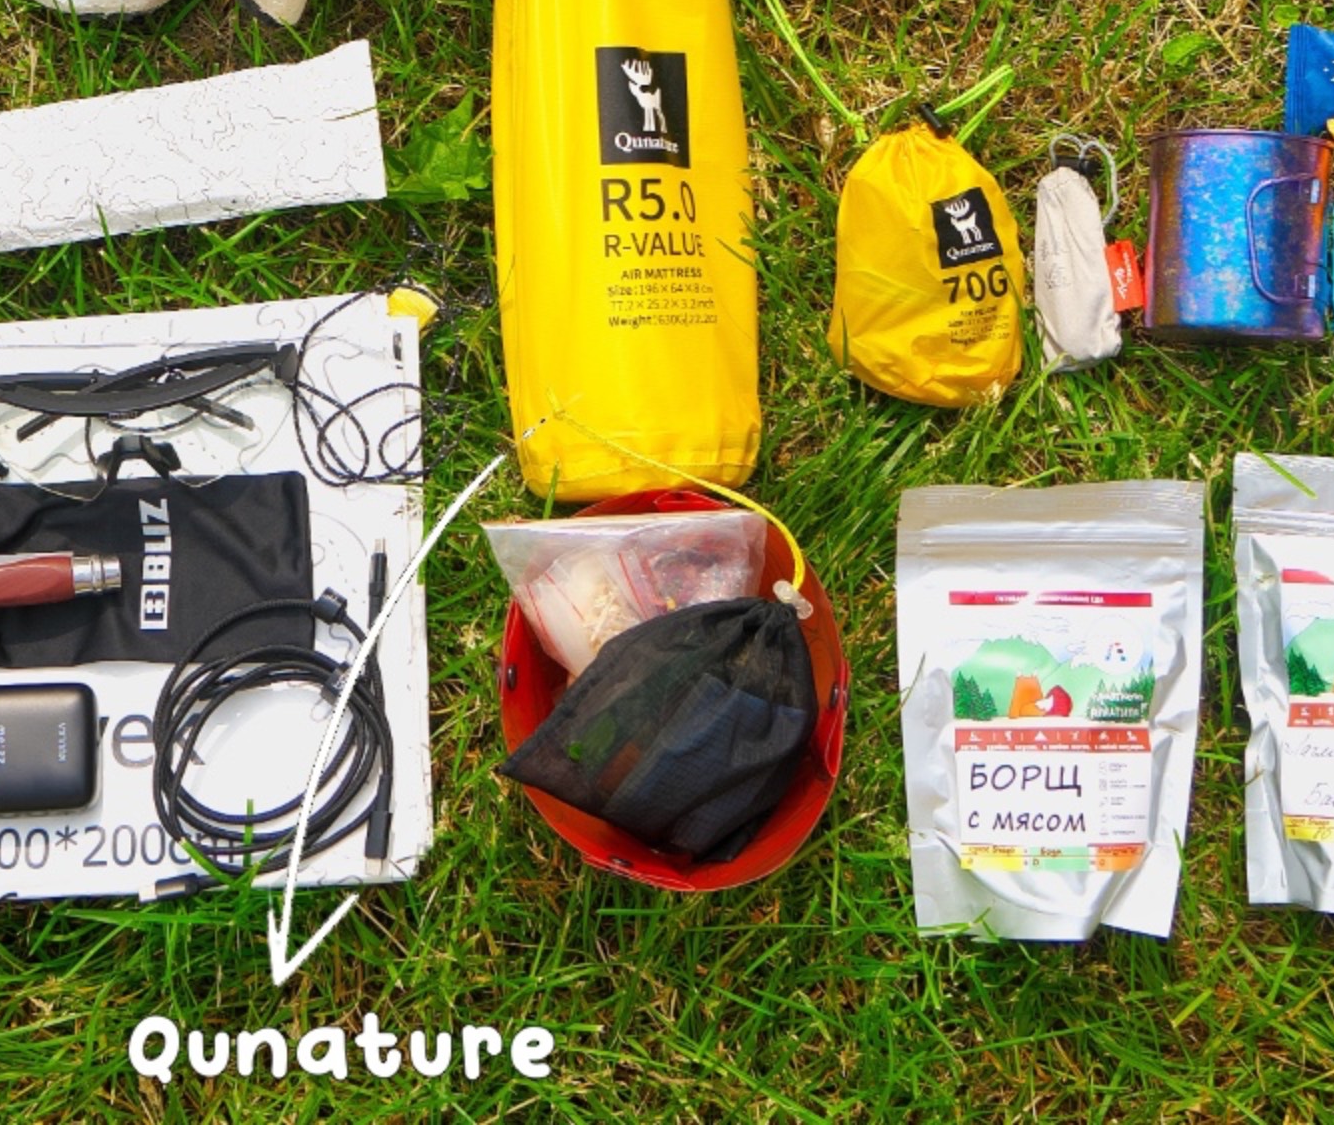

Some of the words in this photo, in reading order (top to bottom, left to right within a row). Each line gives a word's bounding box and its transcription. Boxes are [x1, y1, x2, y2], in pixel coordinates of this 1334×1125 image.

[601, 178, 696, 223] R5.0
[604, 231, 706, 258] R-VALUE
[621, 269, 642, 280] AIR
[644, 267, 702, 279] MATTRESS
[942, 264, 1009, 304] 70G
[138, 498, 172, 580] BLIZ
[970, 762, 1082, 798] БОРЩ
